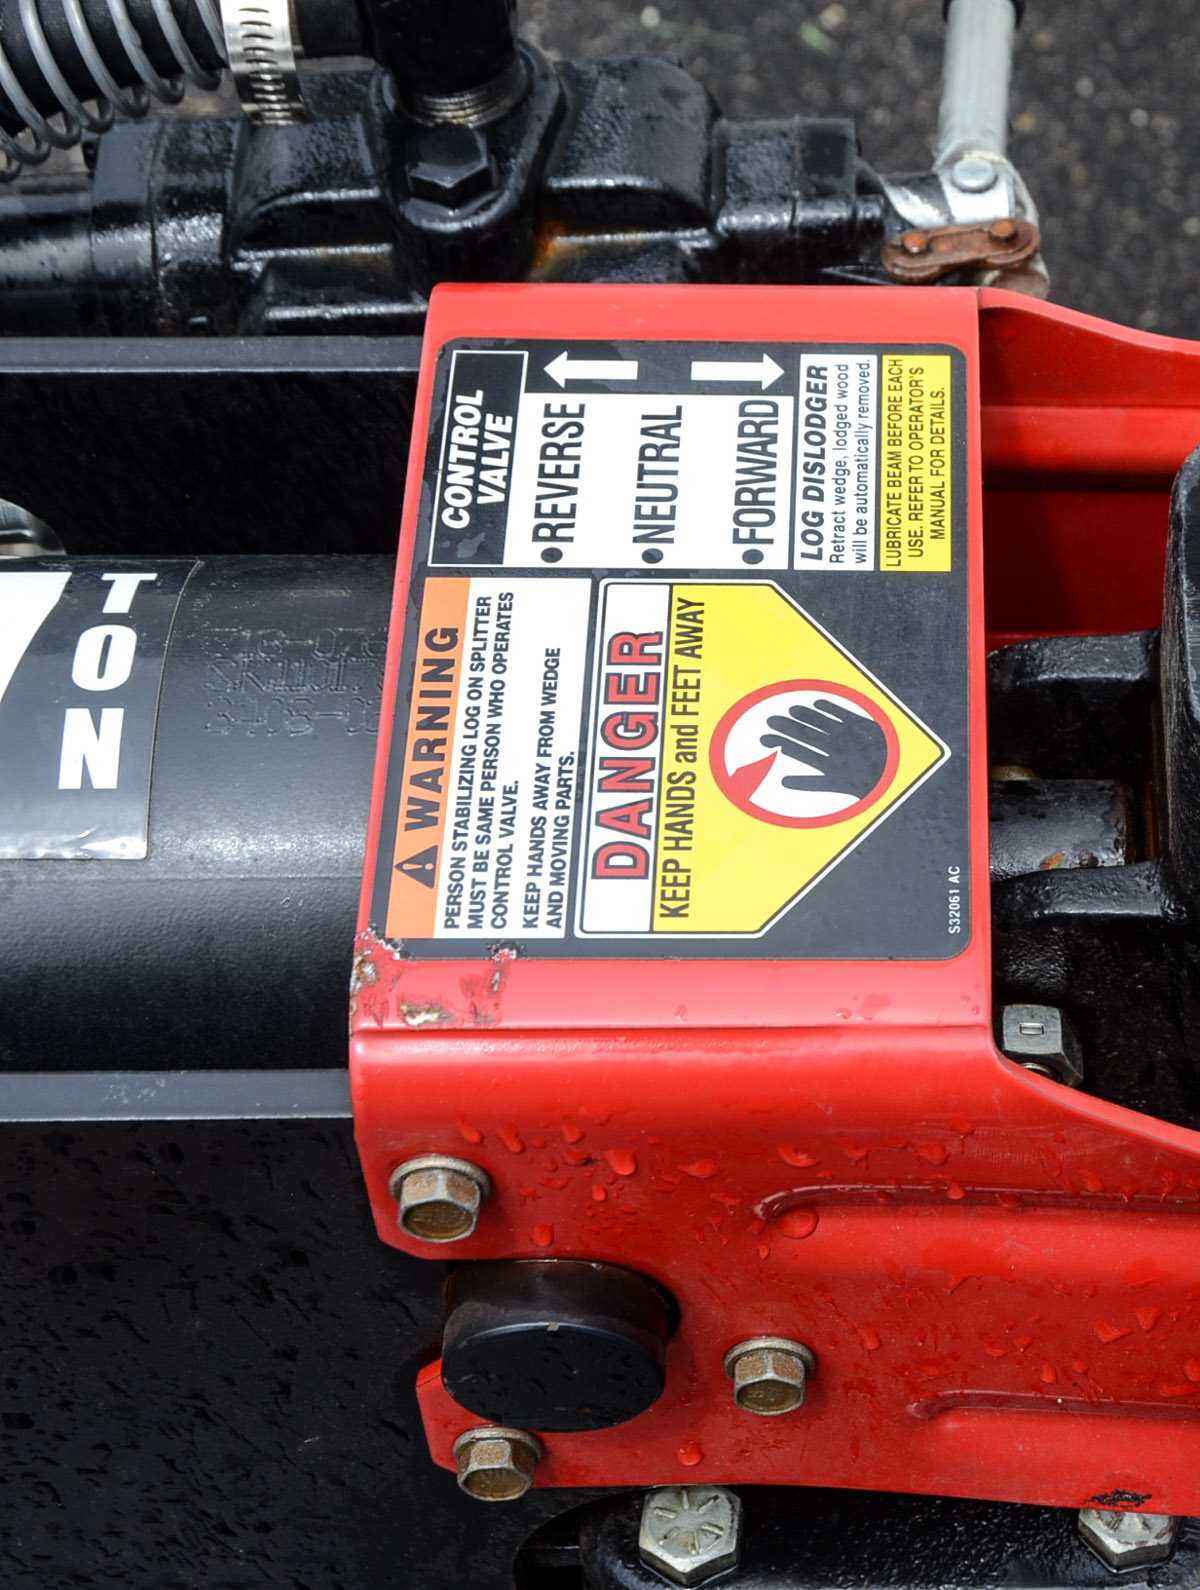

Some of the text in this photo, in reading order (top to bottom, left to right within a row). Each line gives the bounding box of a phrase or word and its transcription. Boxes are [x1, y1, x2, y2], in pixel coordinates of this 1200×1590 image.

[441, 389, 483, 529] CONTROL
[477, 413, 513, 504] VALVE
[532, 403, 585, 542] REVERSE
[632, 405, 682, 543] NEUTRAL
[732, 400, 779, 544] FORWARD
[800, 365, 828, 560] LOG DISLODGER
[830, 364, 852, 563] Retract wedge, lodged wood
[852, 359, 873, 564] will be automatically removed.
[886, 359, 903, 567] LUBRICATE BEAM BEFORE EACH
[908, 366, 924, 558] USE. REFER TO OPERATOR'S
[930, 386, 945, 540] MANUAL FOR DETAILS.
[58, 572, 158, 790] TON
[404, 627, 459, 831] WARNING
[444, 595, 491, 929] PERSON STABILIZING LOG ON SPLITTER
[467, 591, 514, 929] MUST BE SAME PERSON WHO OPERATES
[591, 631, 664, 879] DANGER
[659, 596, 705, 918] KEEP HANDS and FEET AWAY
[490, 780, 519, 929] CONTROL VALVE.
[522, 648, 561, 929] KEEP HANDS AWAY FROM WEDGE
[546, 751, 575, 929] AND MOVING PARTS.
[948, 866, 960, 934] S32061 AC
